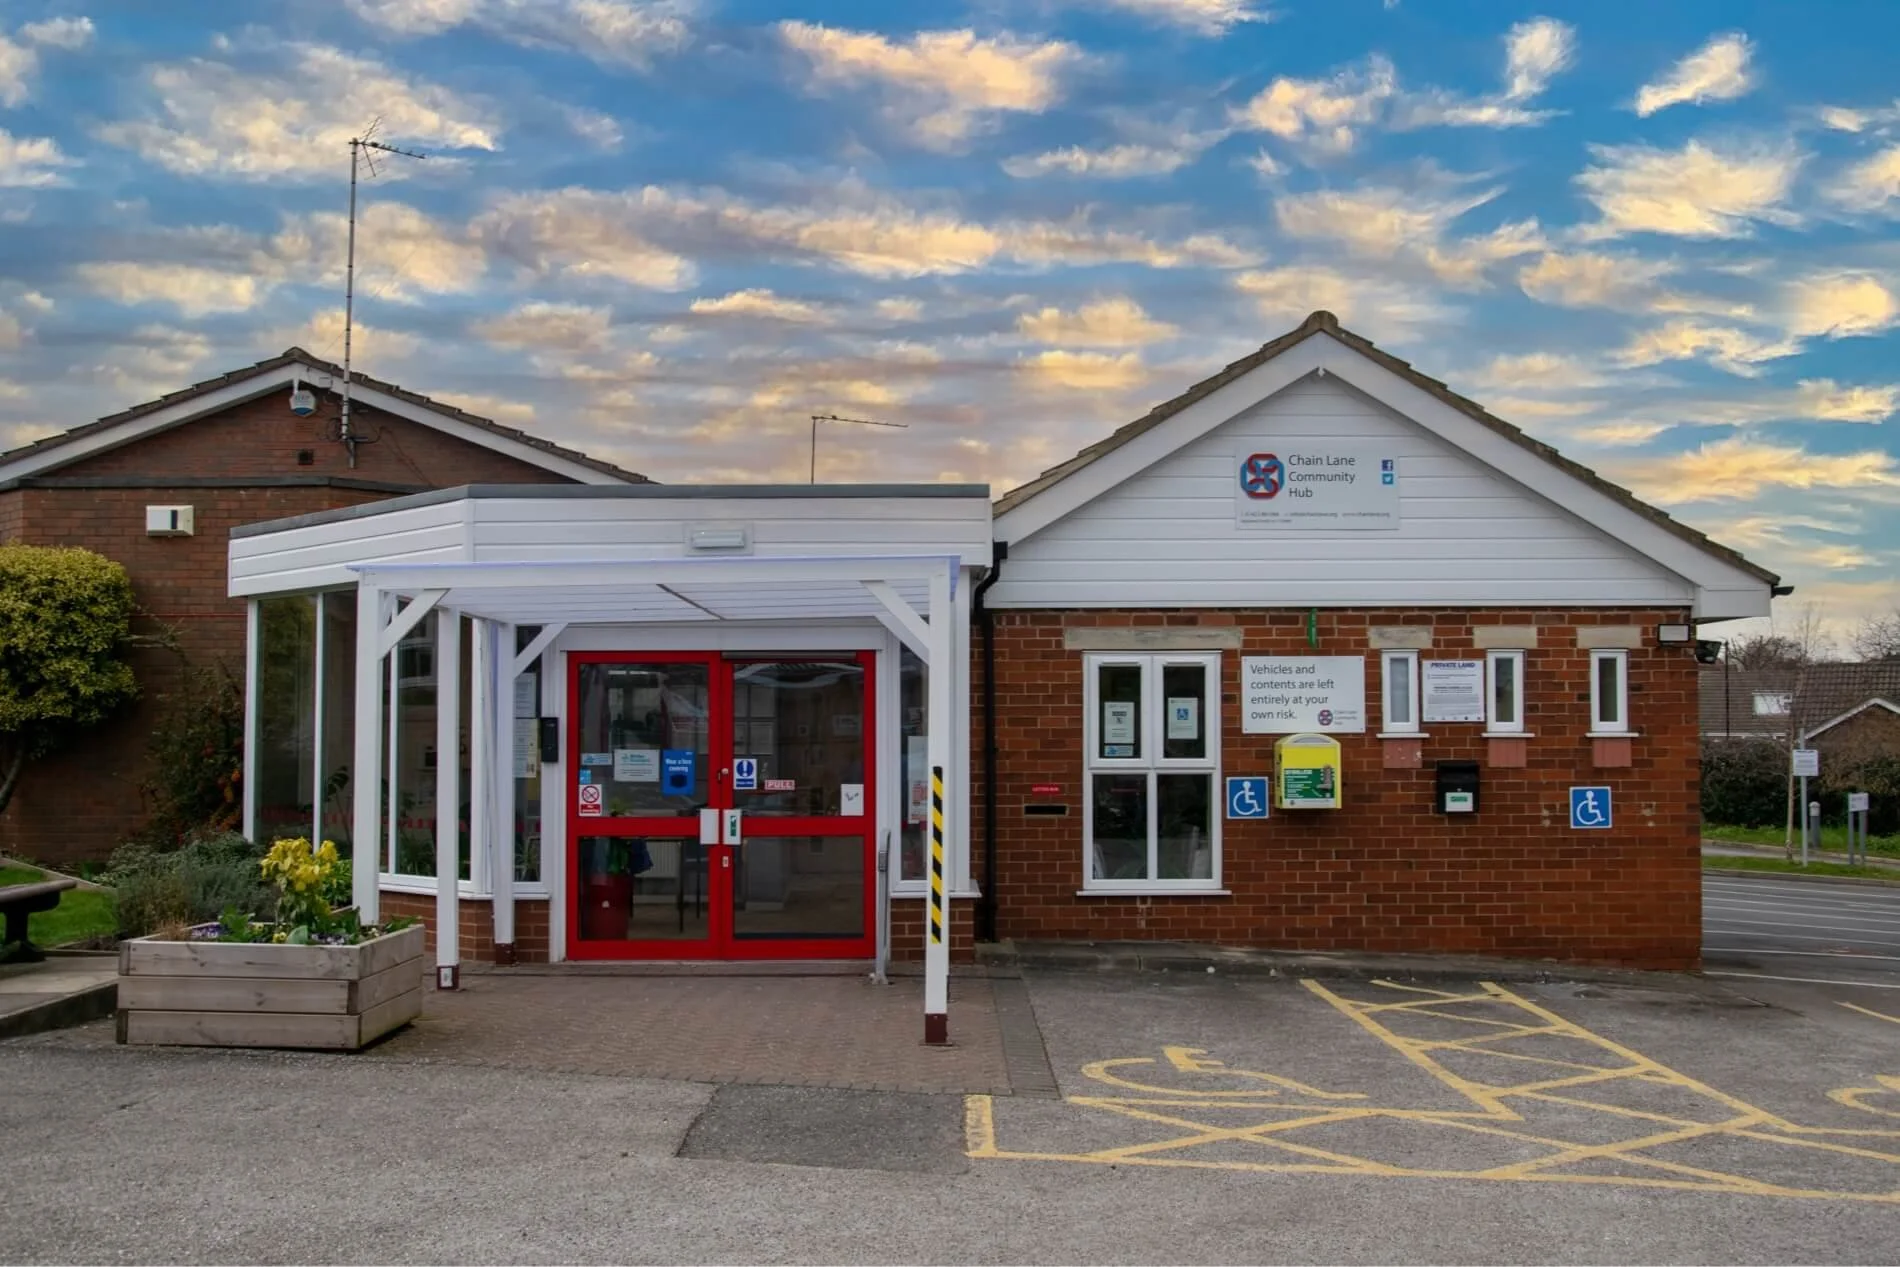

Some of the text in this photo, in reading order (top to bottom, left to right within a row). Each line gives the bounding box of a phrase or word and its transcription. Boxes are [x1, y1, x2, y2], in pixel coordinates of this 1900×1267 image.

[1288, 454, 1356, 466] Chain Lane
[1288, 471, 1356, 484] Community
[1288, 487, 1313, 498] Hub
[1250, 664, 1316, 675] Vehicles and
[1250, 679, 1335, 690] contents are left
[1250, 693, 1329, 707] entirely at your
[1250, 709, 1298, 720] own risk.
